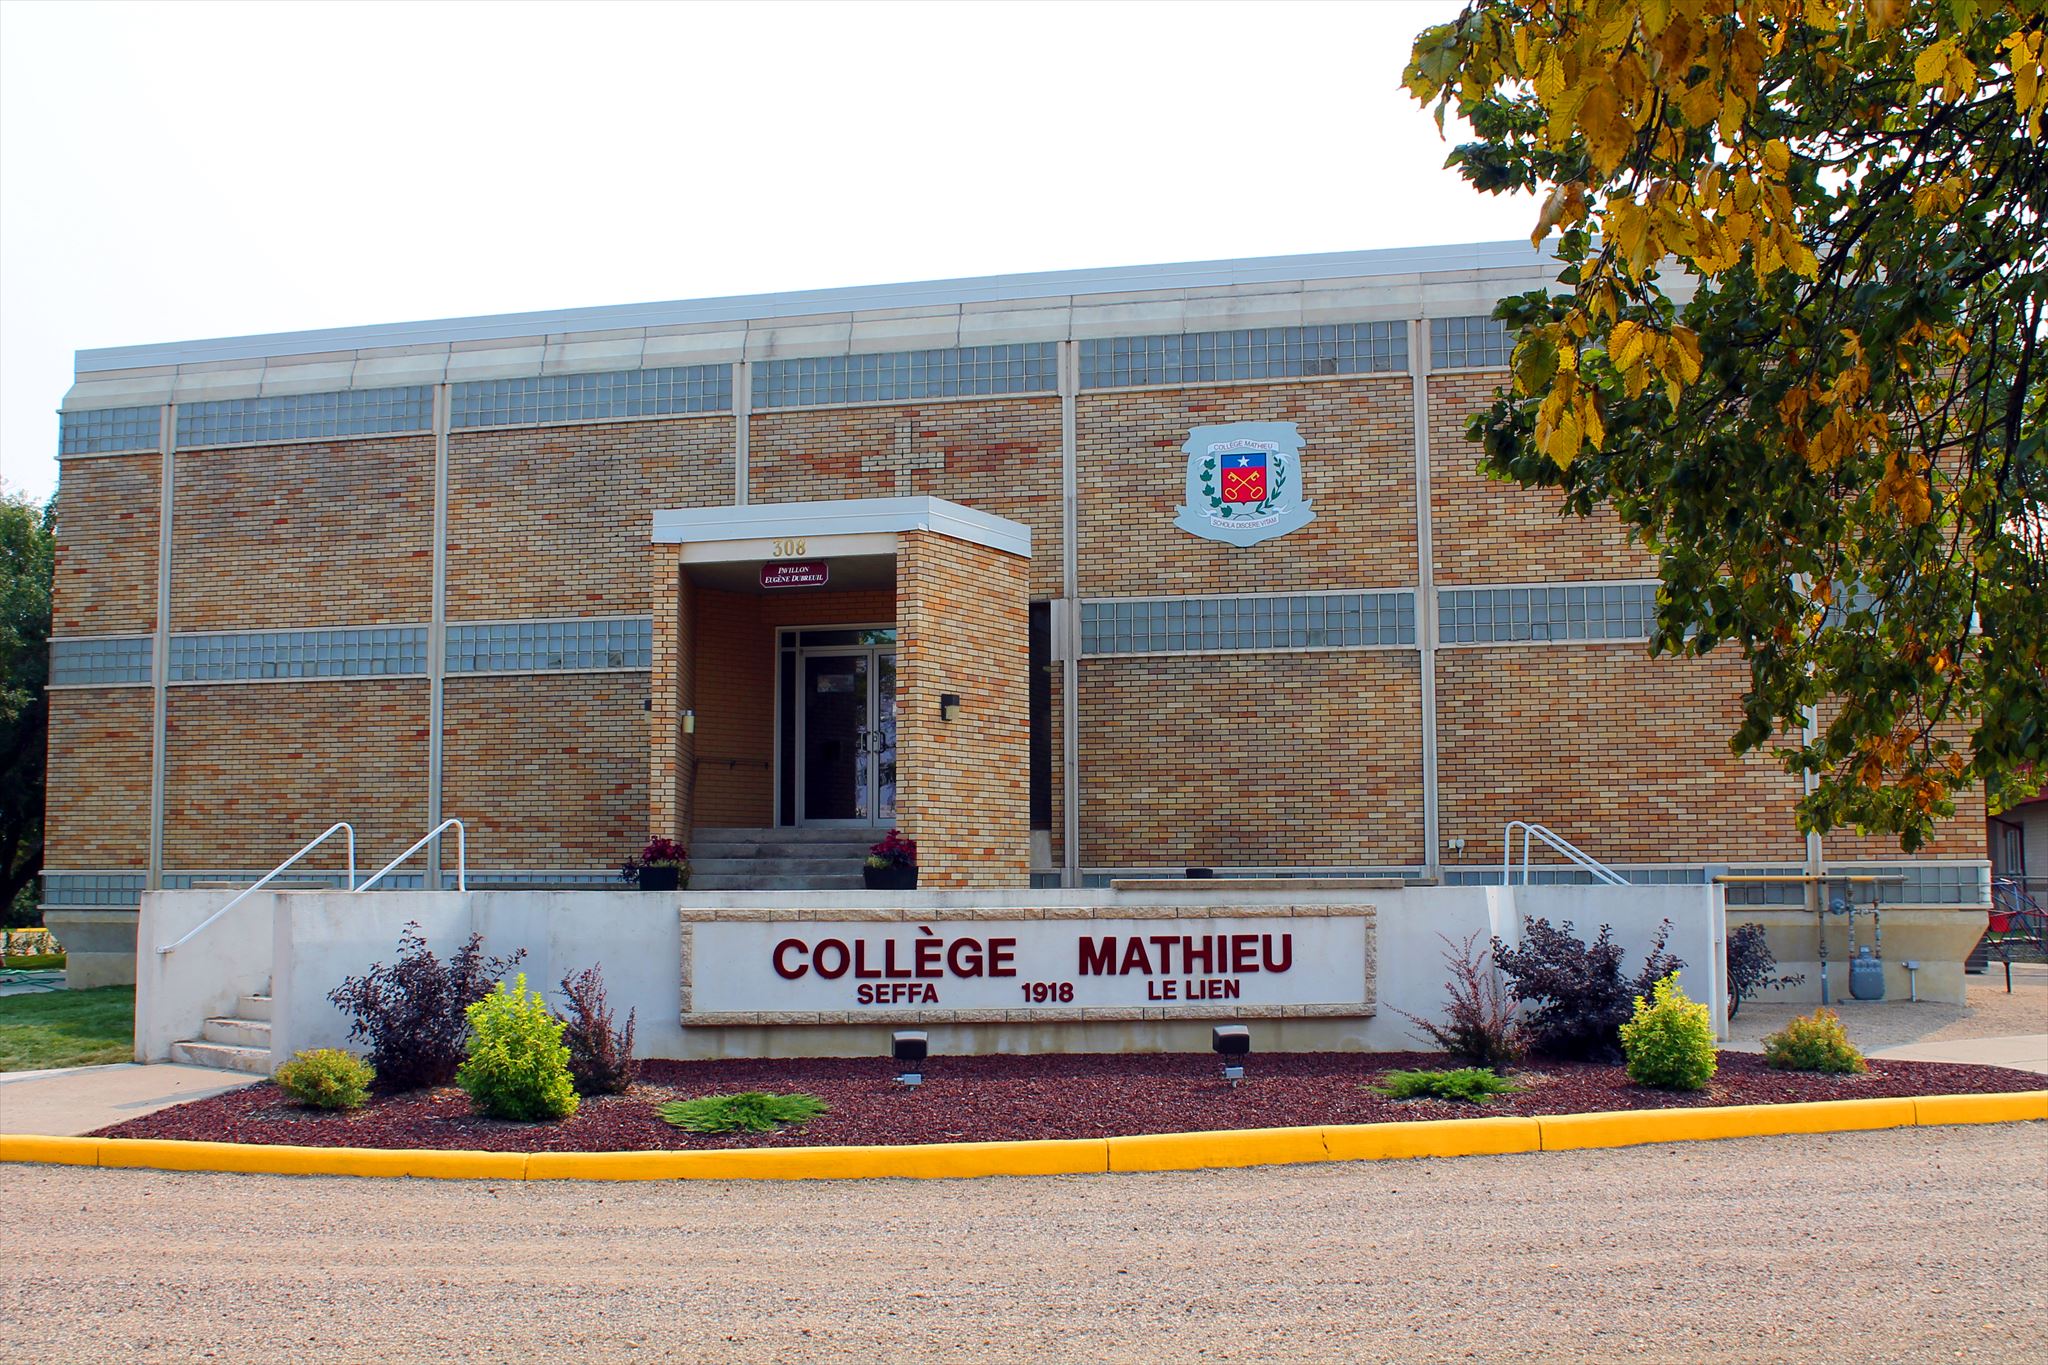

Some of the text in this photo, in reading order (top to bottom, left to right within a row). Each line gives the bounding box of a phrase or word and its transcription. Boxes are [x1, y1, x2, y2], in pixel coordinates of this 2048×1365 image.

[1244, 440, 1273, 449] MATHIEU
[1212, 519, 1235, 528] SCHOLA
[1260, 517, 1277, 526] VITAM
[772, 538, 806, 557] 308
[778, 566, 809, 574] PAVILLON
[791, 573, 823, 582] DUBREUIL
[774, 925, 1292, 979] COLLÈGE MATHIEU
[857, 983, 939, 1004] SEFFA
[1021, 982, 1073, 1002] 1918
[1147, 979, 1240, 999] LE LIEN
